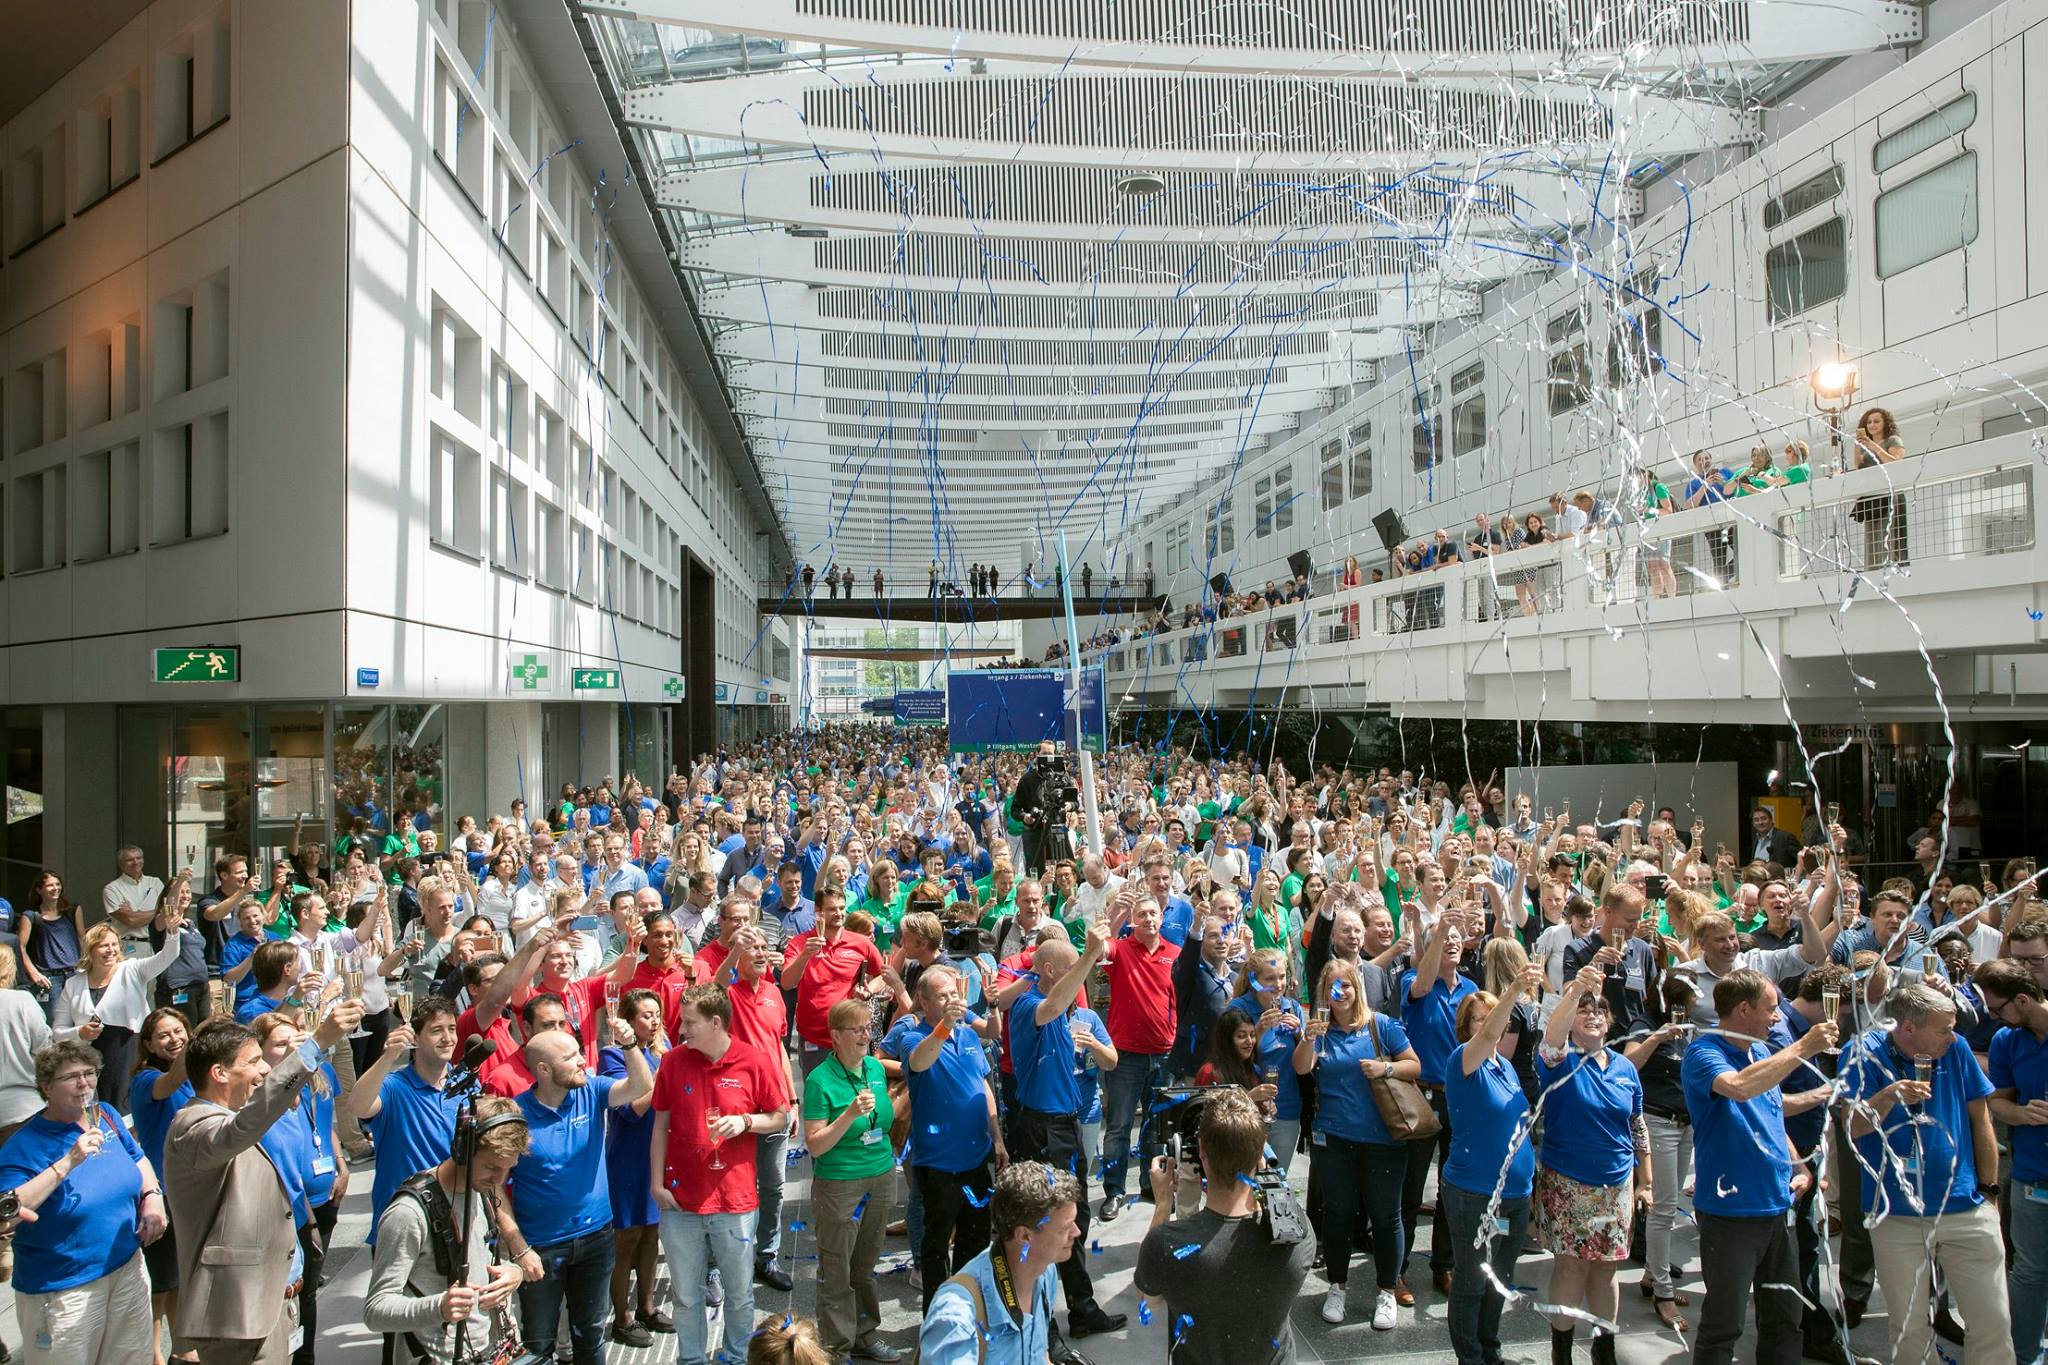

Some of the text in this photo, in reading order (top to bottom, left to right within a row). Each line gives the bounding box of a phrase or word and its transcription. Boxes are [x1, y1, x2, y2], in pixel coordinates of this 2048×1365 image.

[1019, 672, 1051, 680] Ziekenhuis
[1811, 724, 1884, 738] Ziekenhuis
[1003, 1280, 1016, 1306] Nikon
